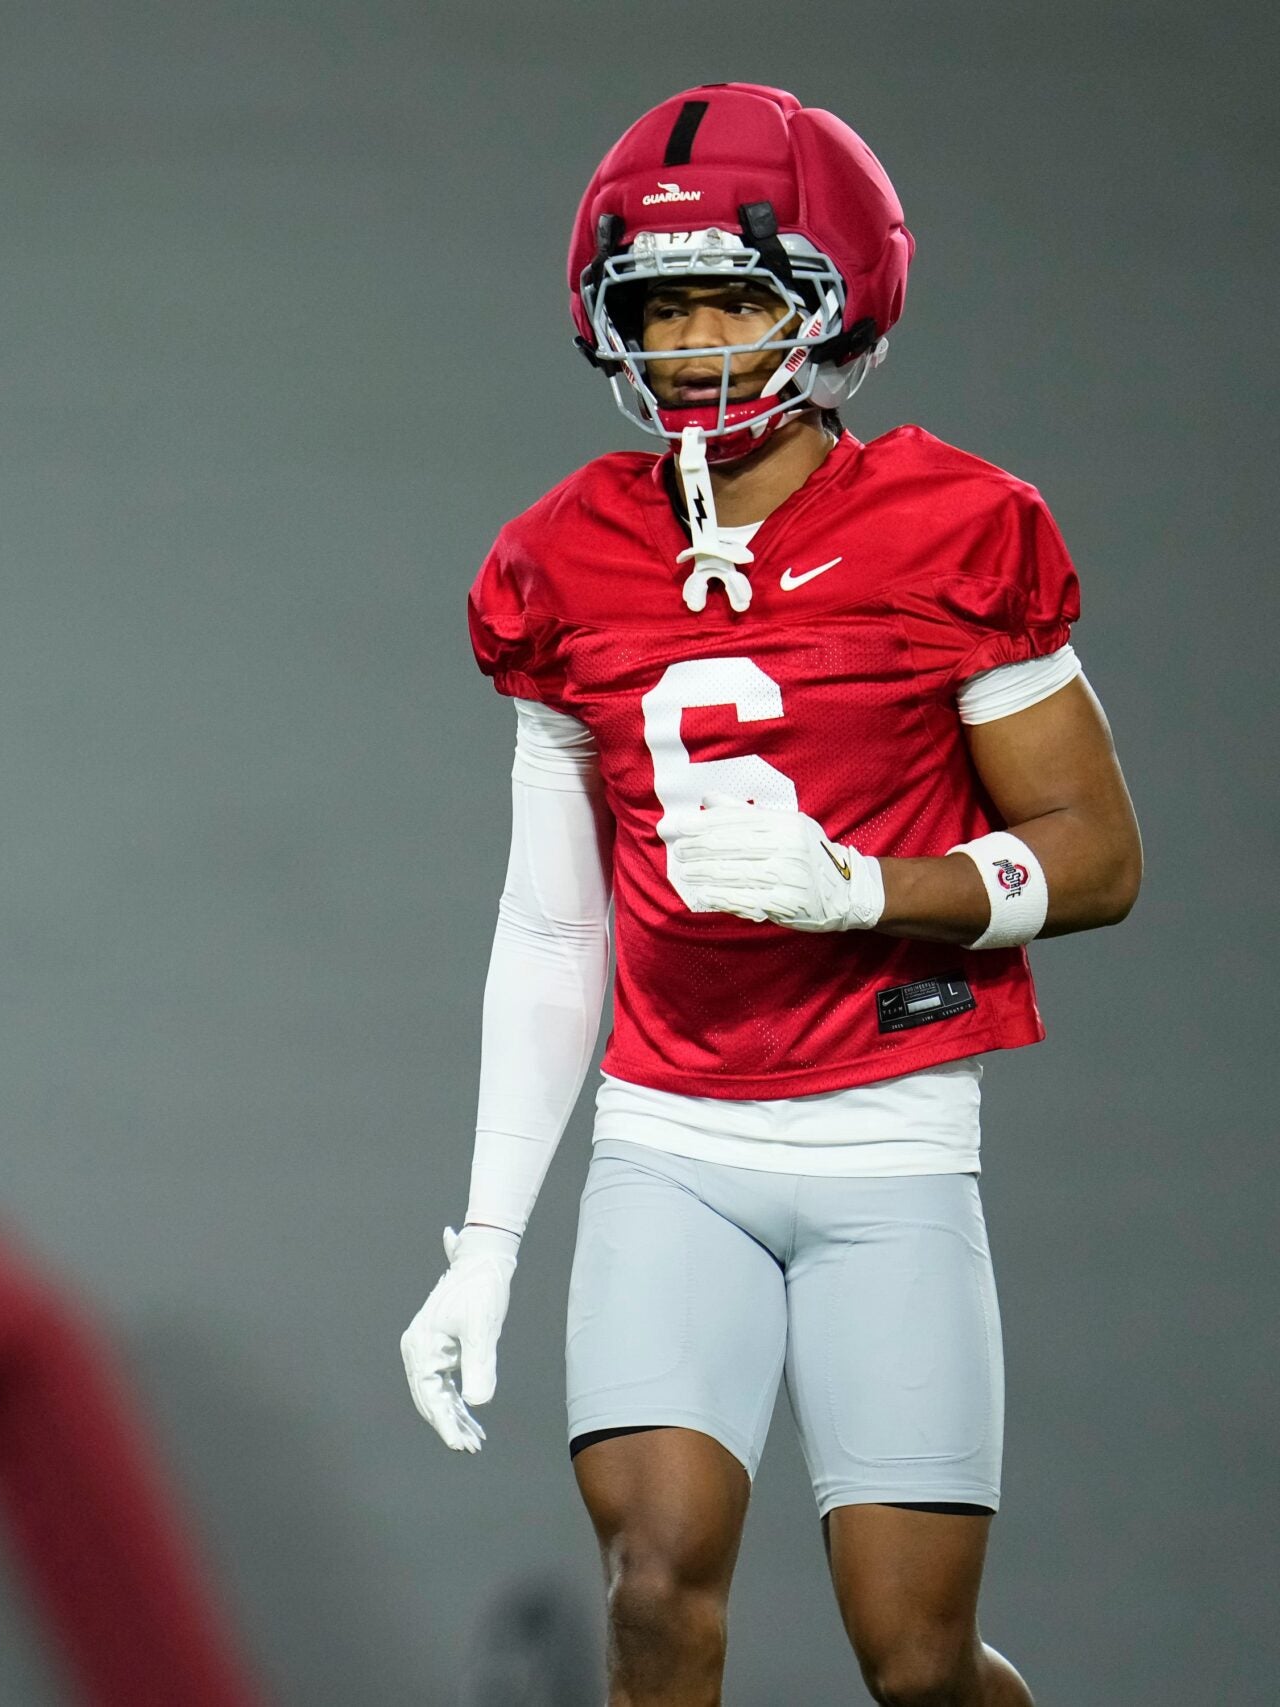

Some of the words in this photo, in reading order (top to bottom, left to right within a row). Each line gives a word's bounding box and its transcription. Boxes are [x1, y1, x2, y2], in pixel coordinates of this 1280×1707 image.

[642, 190, 701, 205] GUARDIAN
[784, 348, 807, 373] OHIO
[641, 656, 799, 912] 6
[992, 859, 1017, 877] OHIO
[1005, 872, 1022, 900] STATE
[947, 983, 958, 996] L
